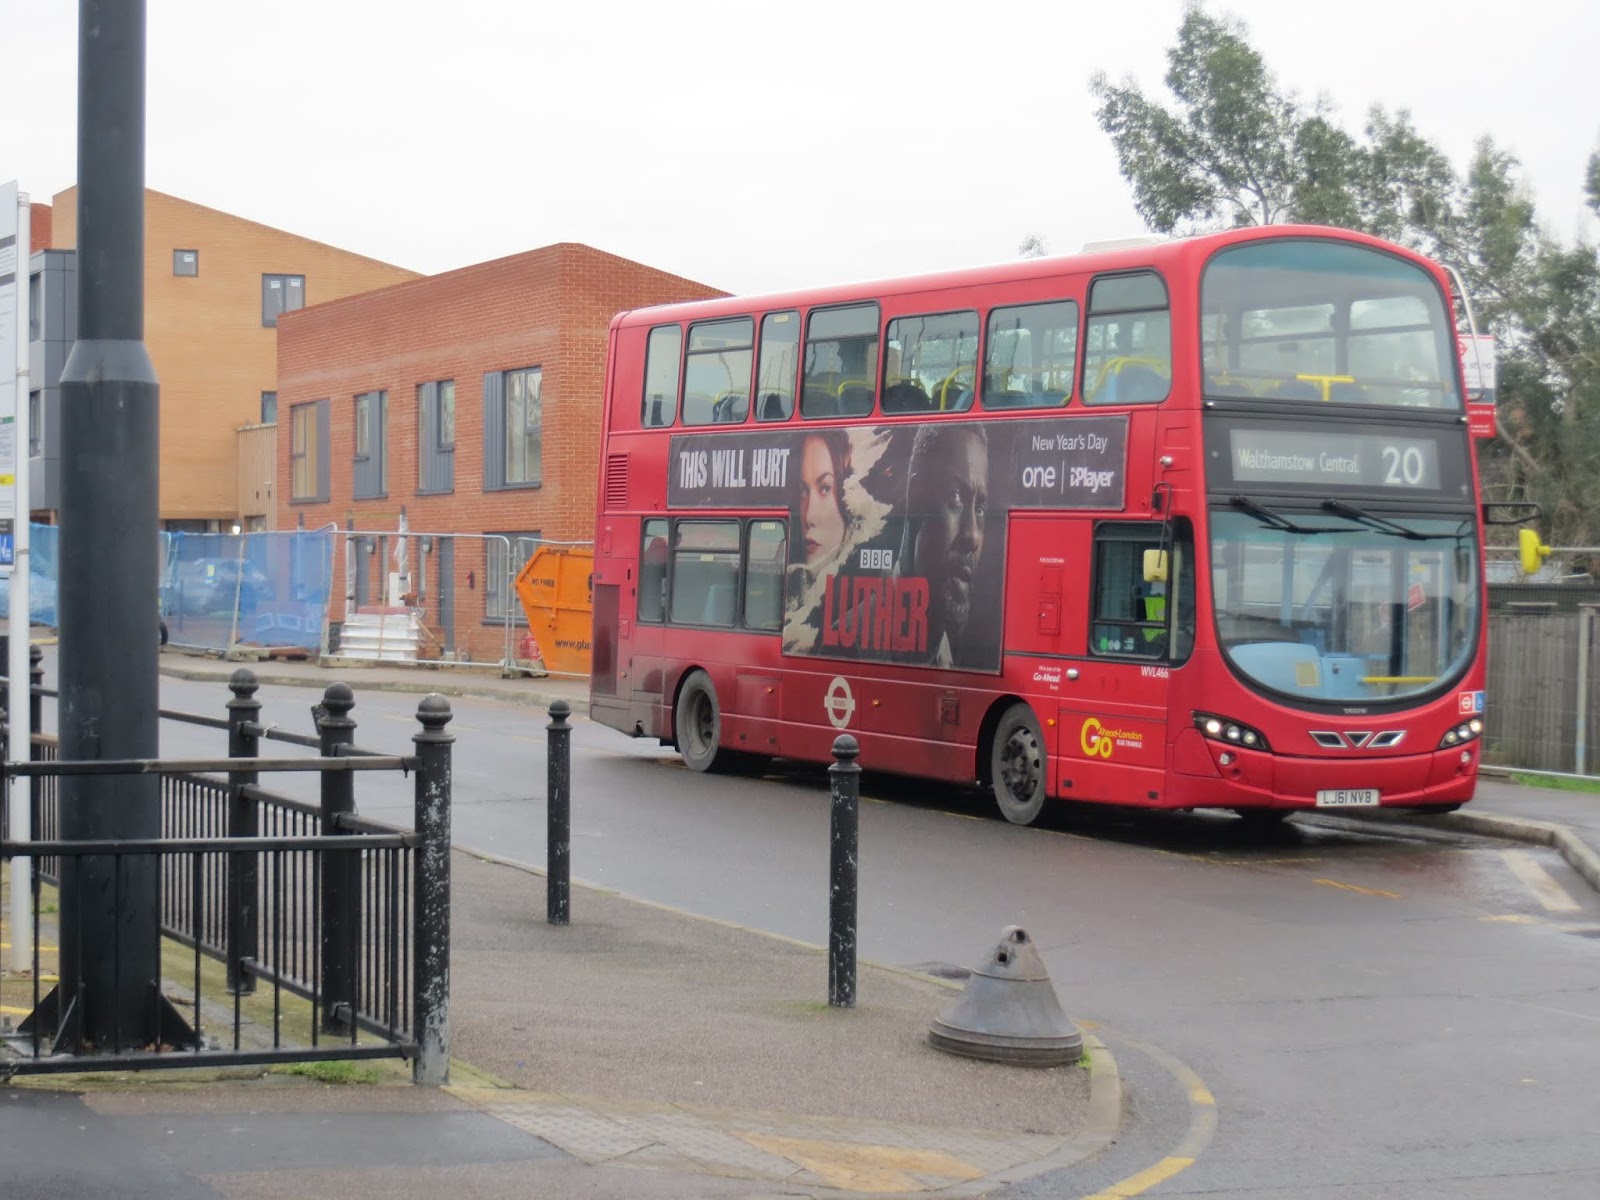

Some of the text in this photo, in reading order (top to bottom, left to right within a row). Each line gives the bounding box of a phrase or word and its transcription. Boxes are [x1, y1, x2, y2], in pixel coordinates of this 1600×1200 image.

[1032, 433, 1108, 454] New Year's Day
[679, 448, 790, 489] THIS WILL HURT
[1238, 446, 1424, 485] Walthamstow Central 20
[1022, 466, 1114, 493] one iPlayer
[860, 549, 893, 569] BBC
[822, 574, 930, 653] LUTHER
[1141, 665, 1169, 678] WVL466
